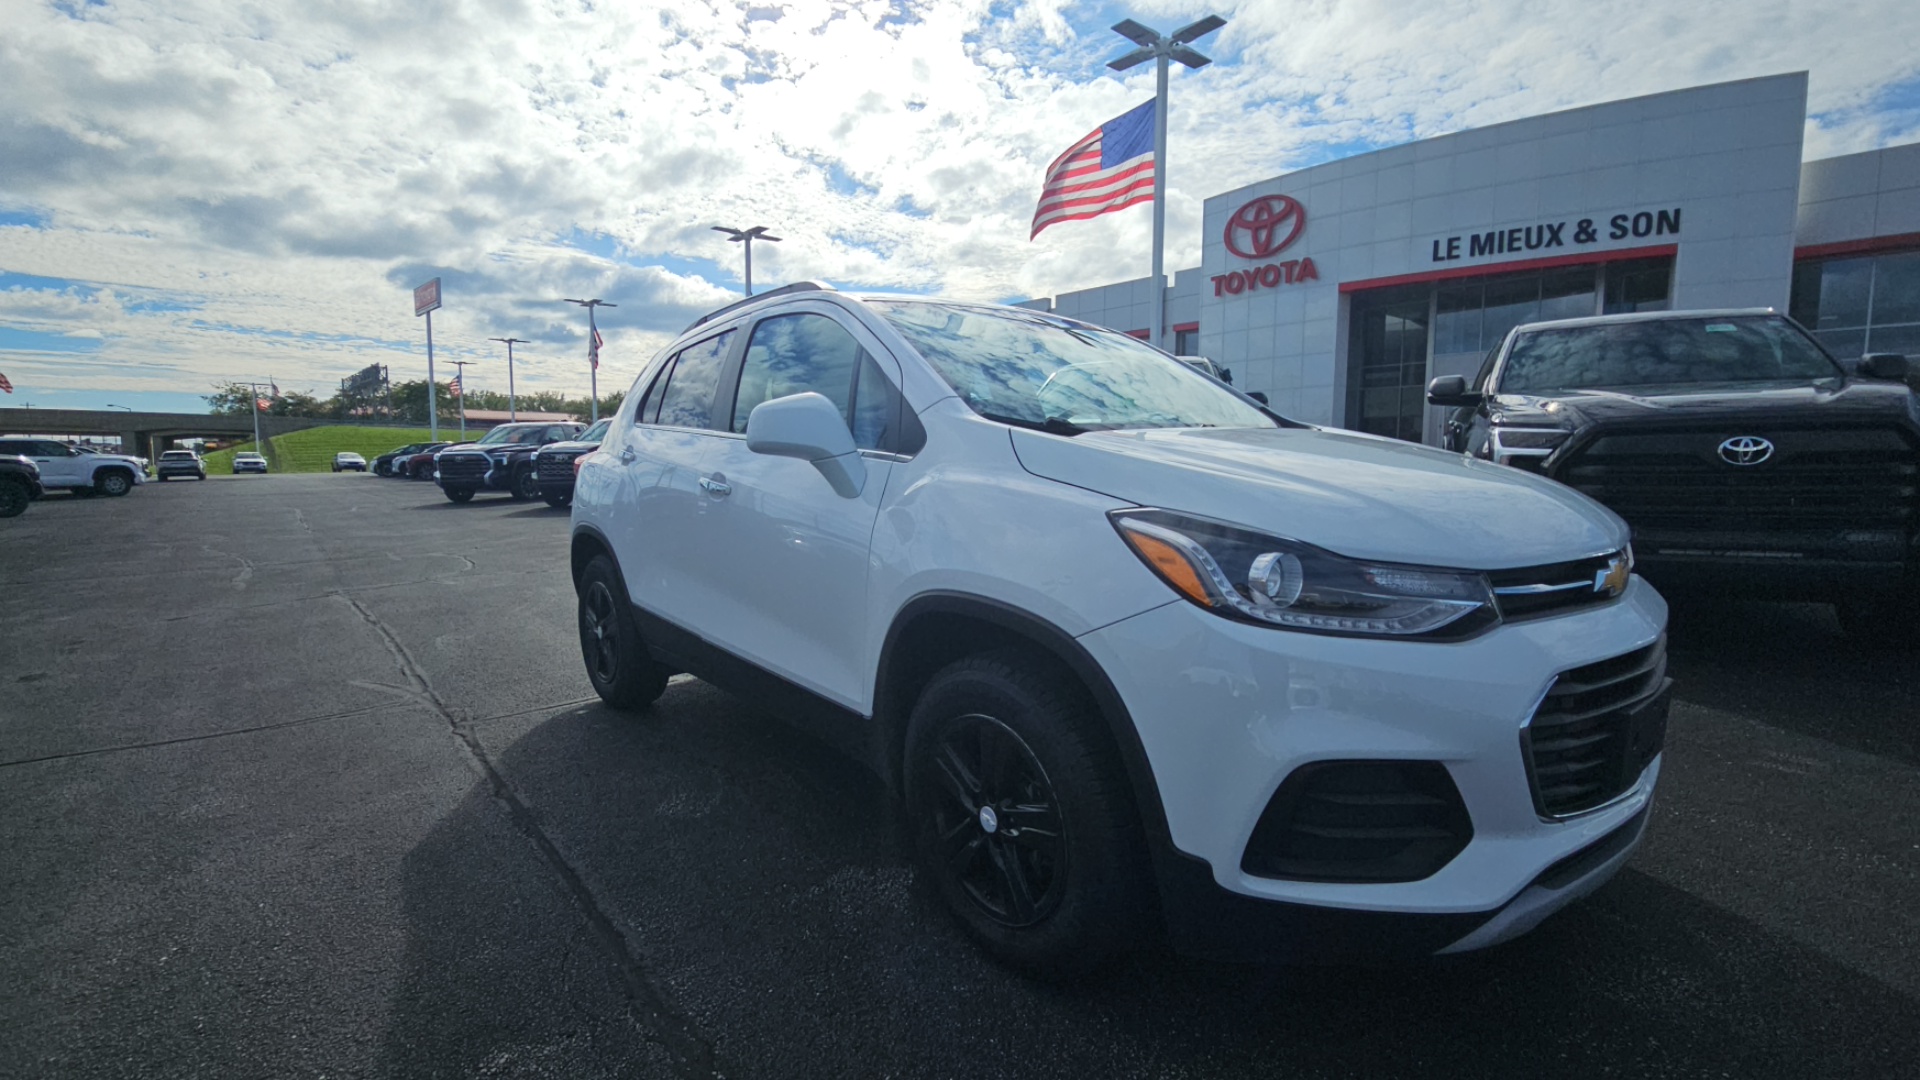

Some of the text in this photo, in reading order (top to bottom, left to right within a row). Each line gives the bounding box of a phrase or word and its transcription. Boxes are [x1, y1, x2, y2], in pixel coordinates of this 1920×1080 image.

[1432, 208, 1682, 262] LE MIEUX & SON
[1210, 256, 1319, 298] TOYOTA
